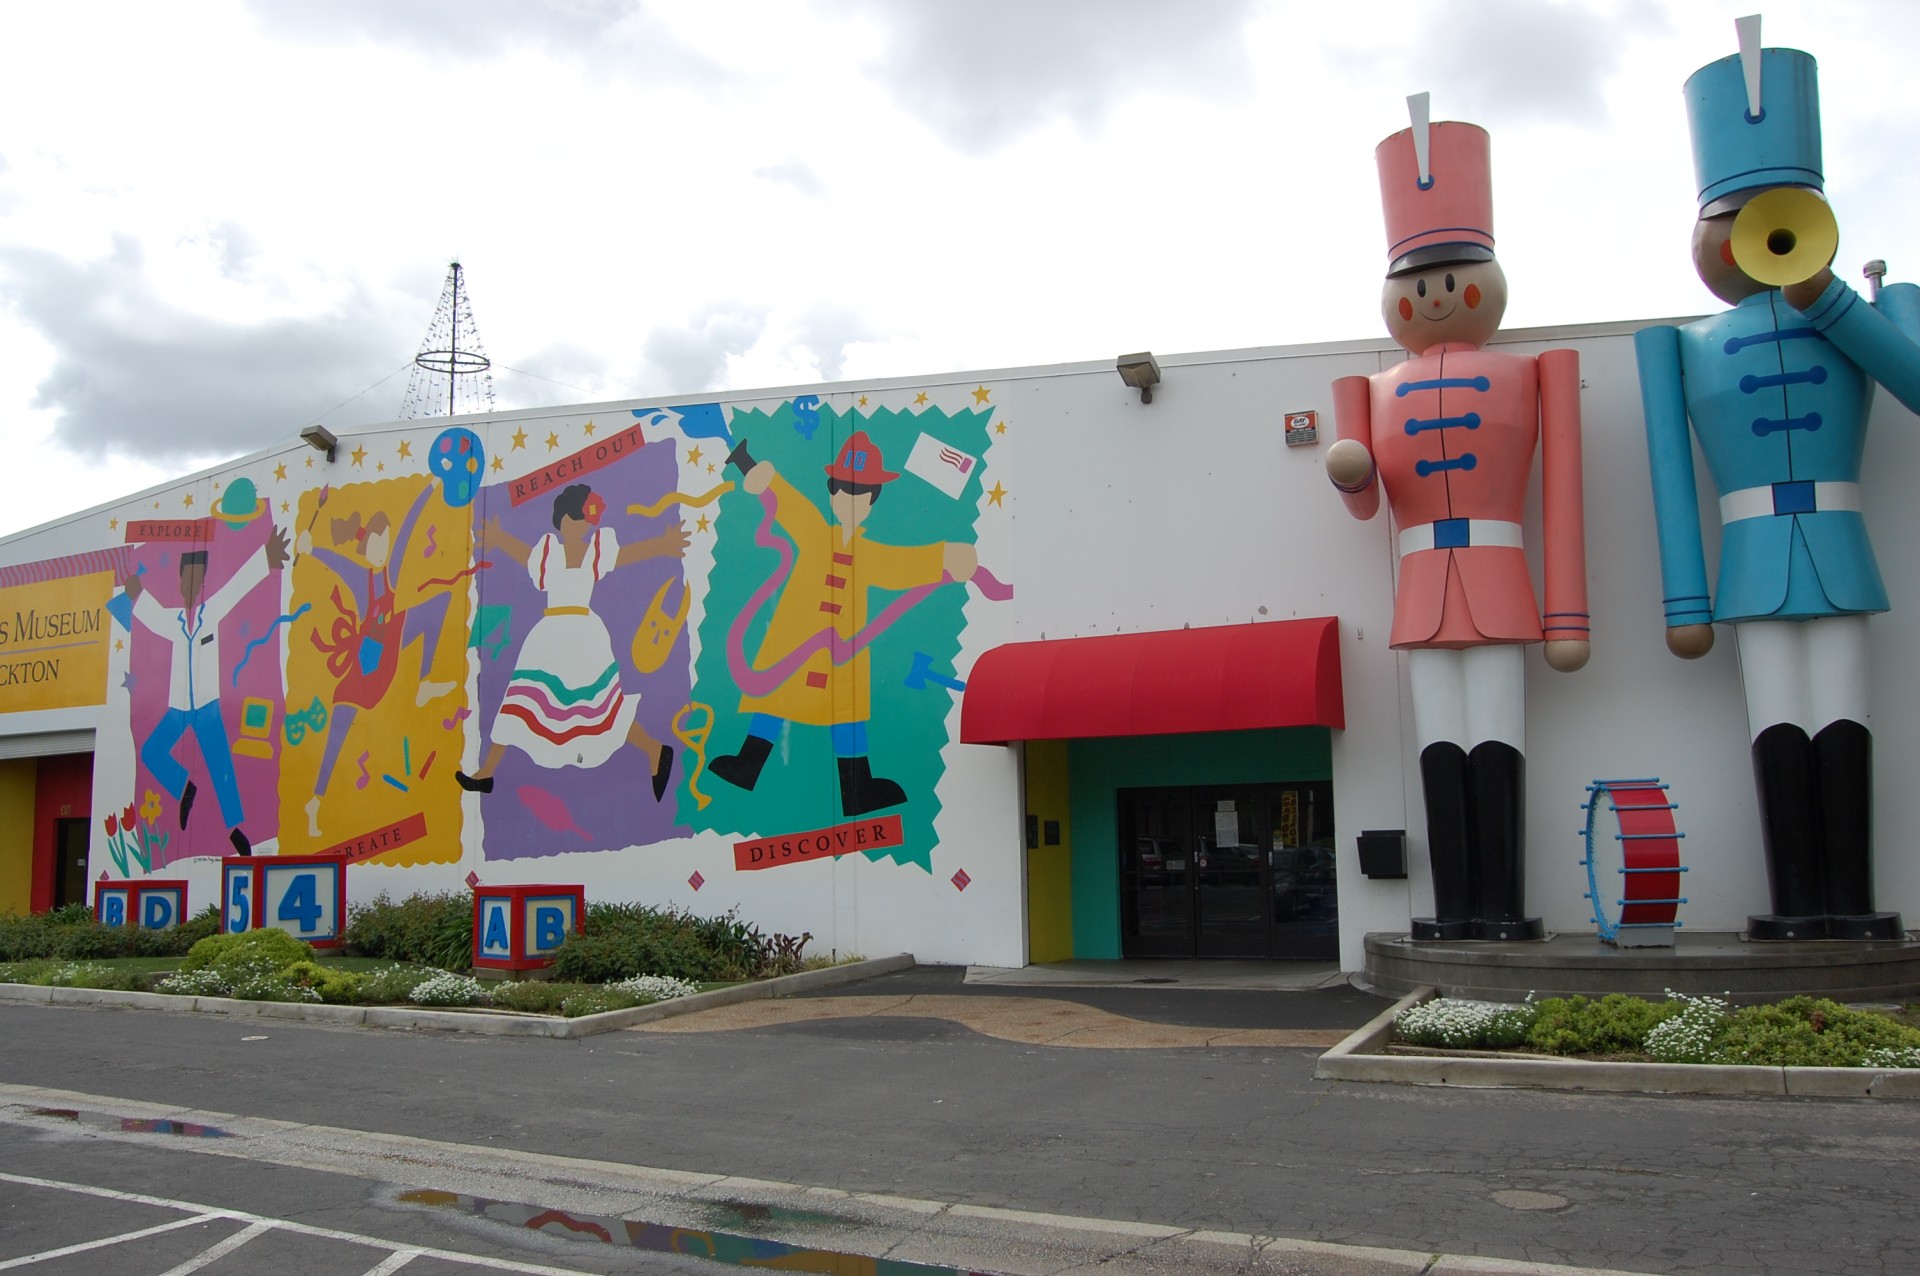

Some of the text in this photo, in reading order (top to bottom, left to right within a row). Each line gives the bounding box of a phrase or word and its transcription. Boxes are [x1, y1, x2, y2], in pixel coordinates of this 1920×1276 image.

[515, 430, 638, 498] REACH OUT
[843, 449, 868, 472] 10
[139, 525, 202, 538] EXPLORE
[13, 608, 101, 643] MUSEUM
[750, 824, 887, 863] DISCOVER
[106, 896, 124, 928] B
[144, 895, 173, 930] D
[230, 875, 250, 934] 5
[278, 873, 323, 933] 4
[484, 905, 509, 950] A
[535, 907, 566, 951] B
